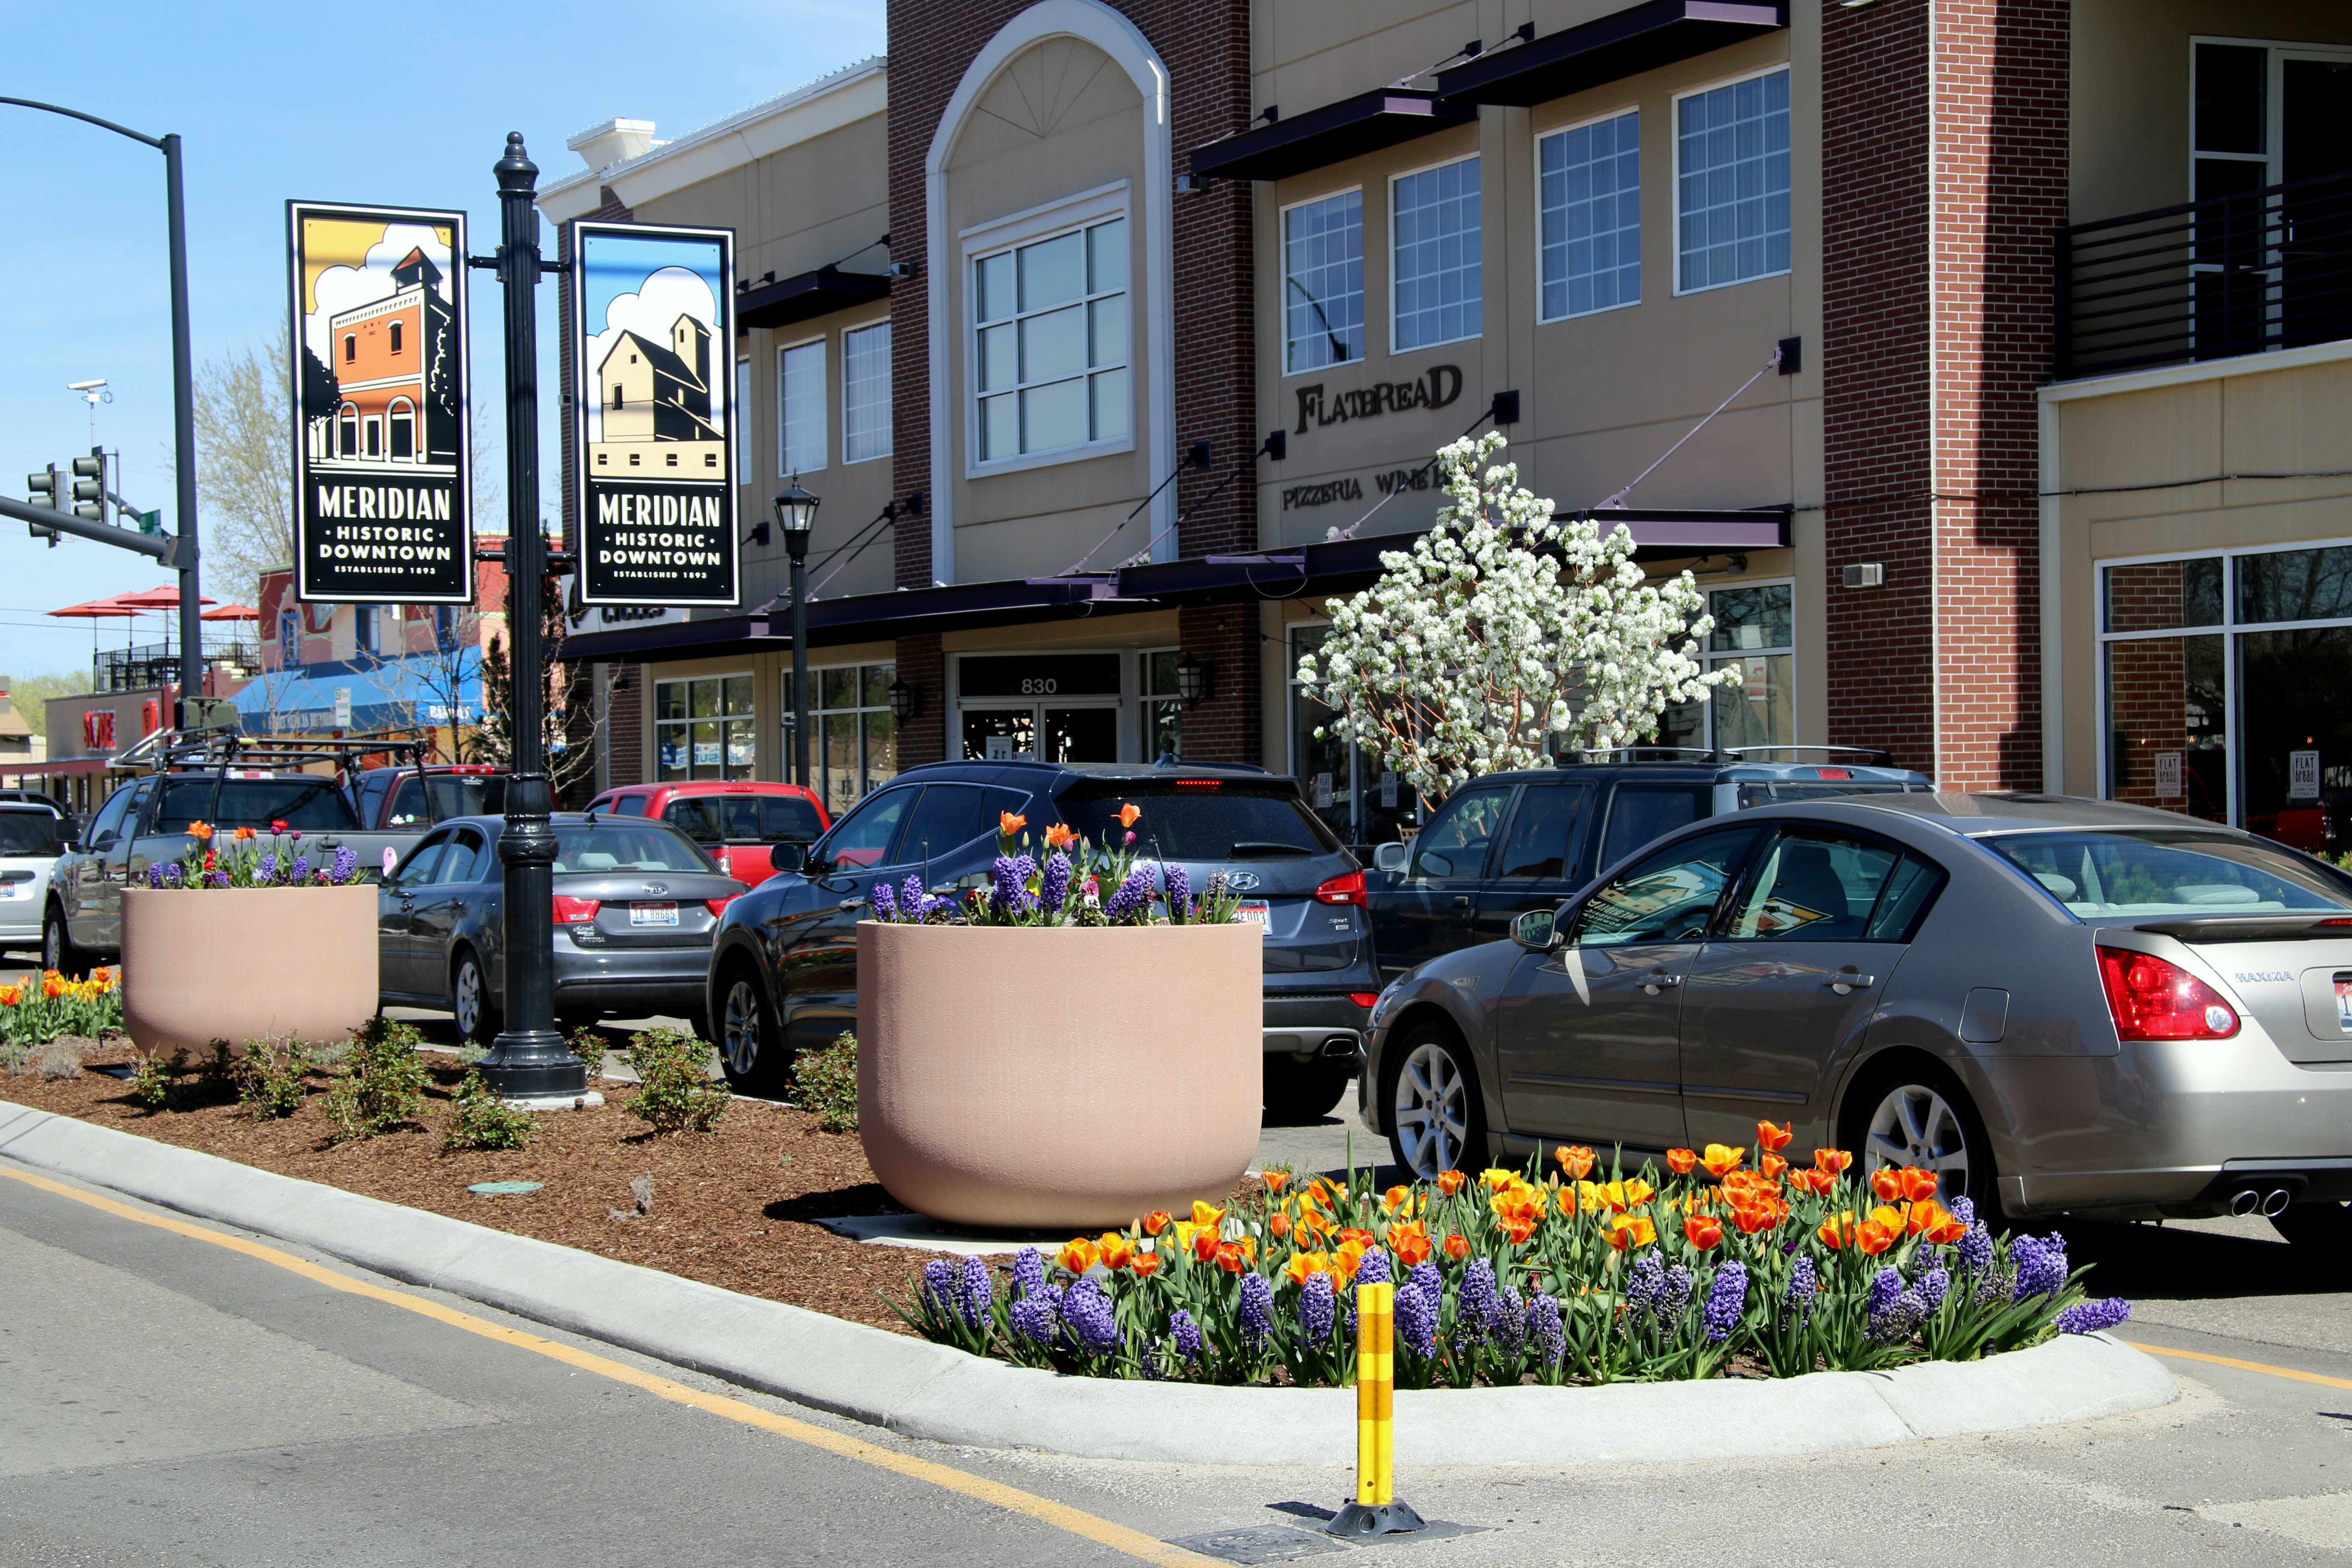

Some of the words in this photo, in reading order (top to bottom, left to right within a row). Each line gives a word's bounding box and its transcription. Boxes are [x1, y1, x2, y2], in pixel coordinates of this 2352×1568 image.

[1294, 364, 1462, 434] FLATBREAD
[1282, 478, 1363, 510] PIZZERIA
[1375, 465, 1428, 494] WINE
[318, 485, 450, 521] MERIDIAN
[599, 493, 720, 527] MERIDIAN
[337, 526, 433, 542] HISTORIC
[616, 533, 704, 548] HISTORIC
[319, 544, 450, 560] DOWNTOWN
[600, 550, 720, 566] DOWNTOWN
[334, 566, 404, 574] ESTABLISHED
[1022, 678, 1057, 694] 830
[2159, 758, 2177, 770] FLAT
[2295, 757, 2314, 769] FLAT
[2159, 770, 2177, 783] bread
[2295, 769, 2314, 782] bread
[634, 909, 644, 919] 1A
[2235, 971, 2294, 983] MAXIMA
